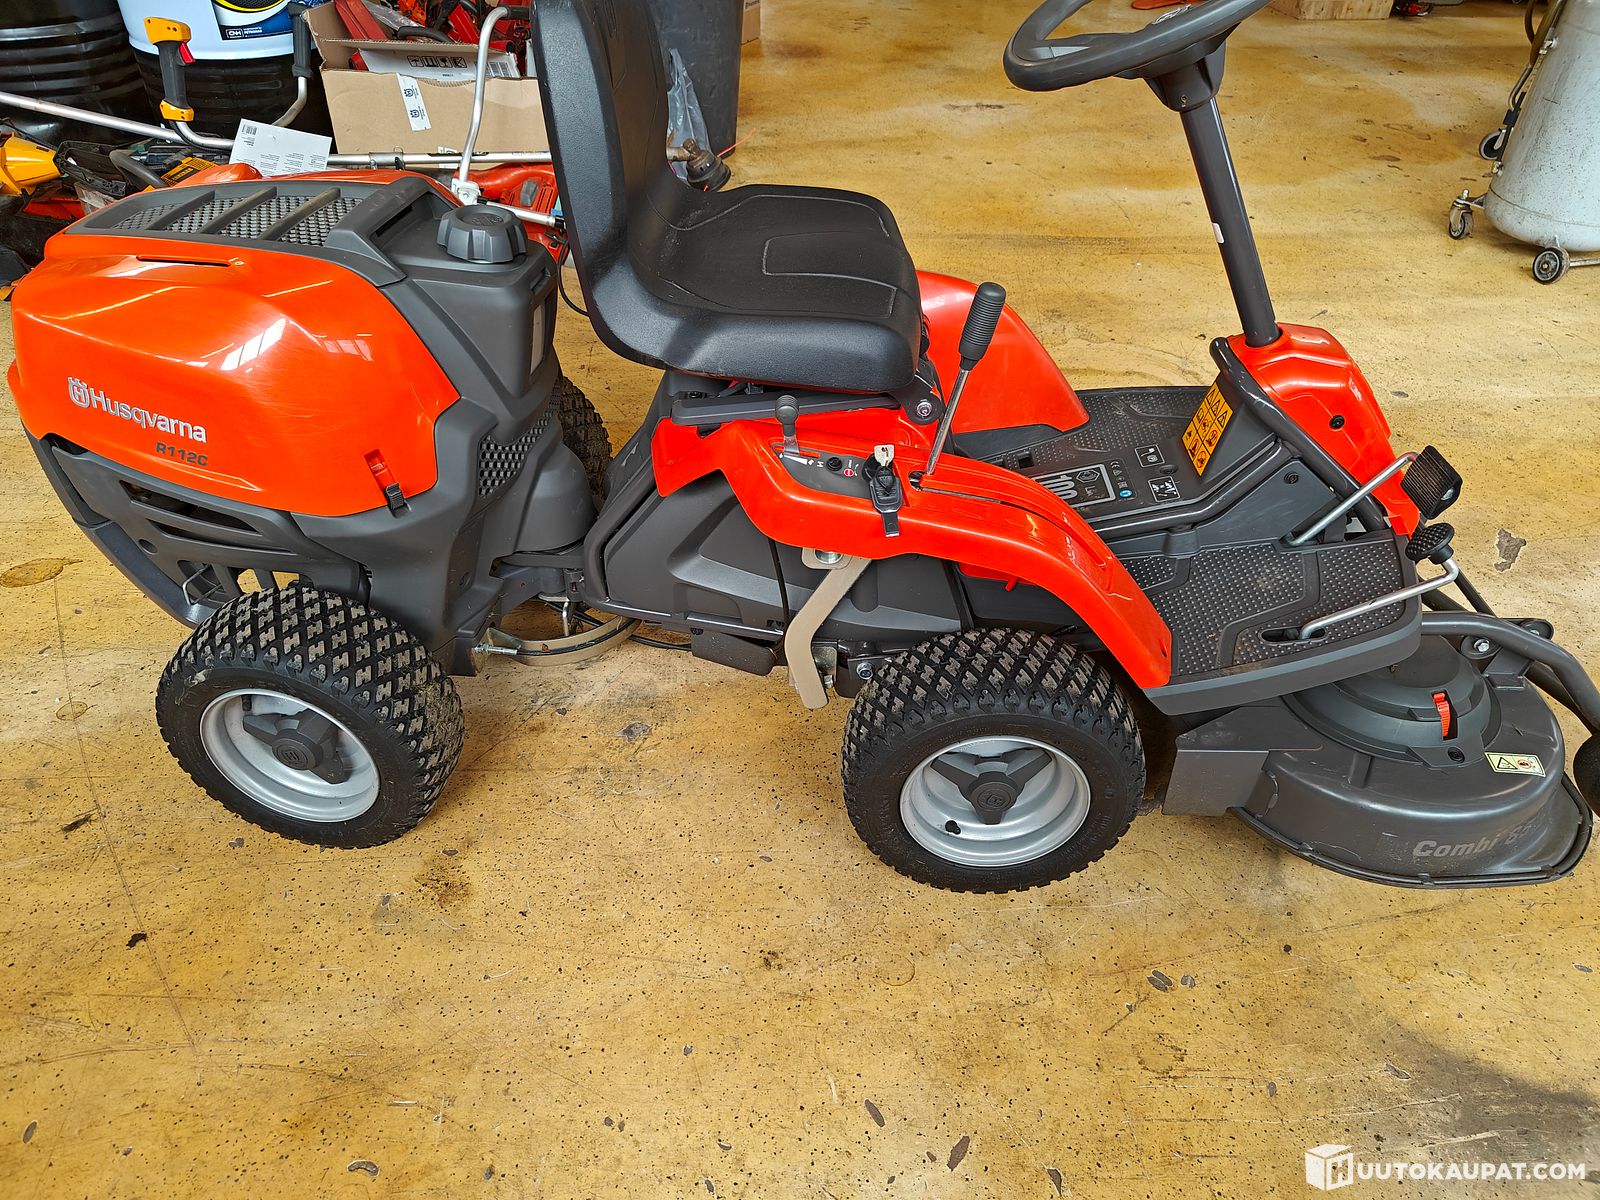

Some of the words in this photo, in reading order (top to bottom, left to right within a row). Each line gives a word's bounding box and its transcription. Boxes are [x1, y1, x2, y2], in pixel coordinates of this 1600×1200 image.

[89, 387, 207, 443] Husqvarna
[155, 442, 209, 467] R112C
[1412, 833, 1501, 857] Combi
